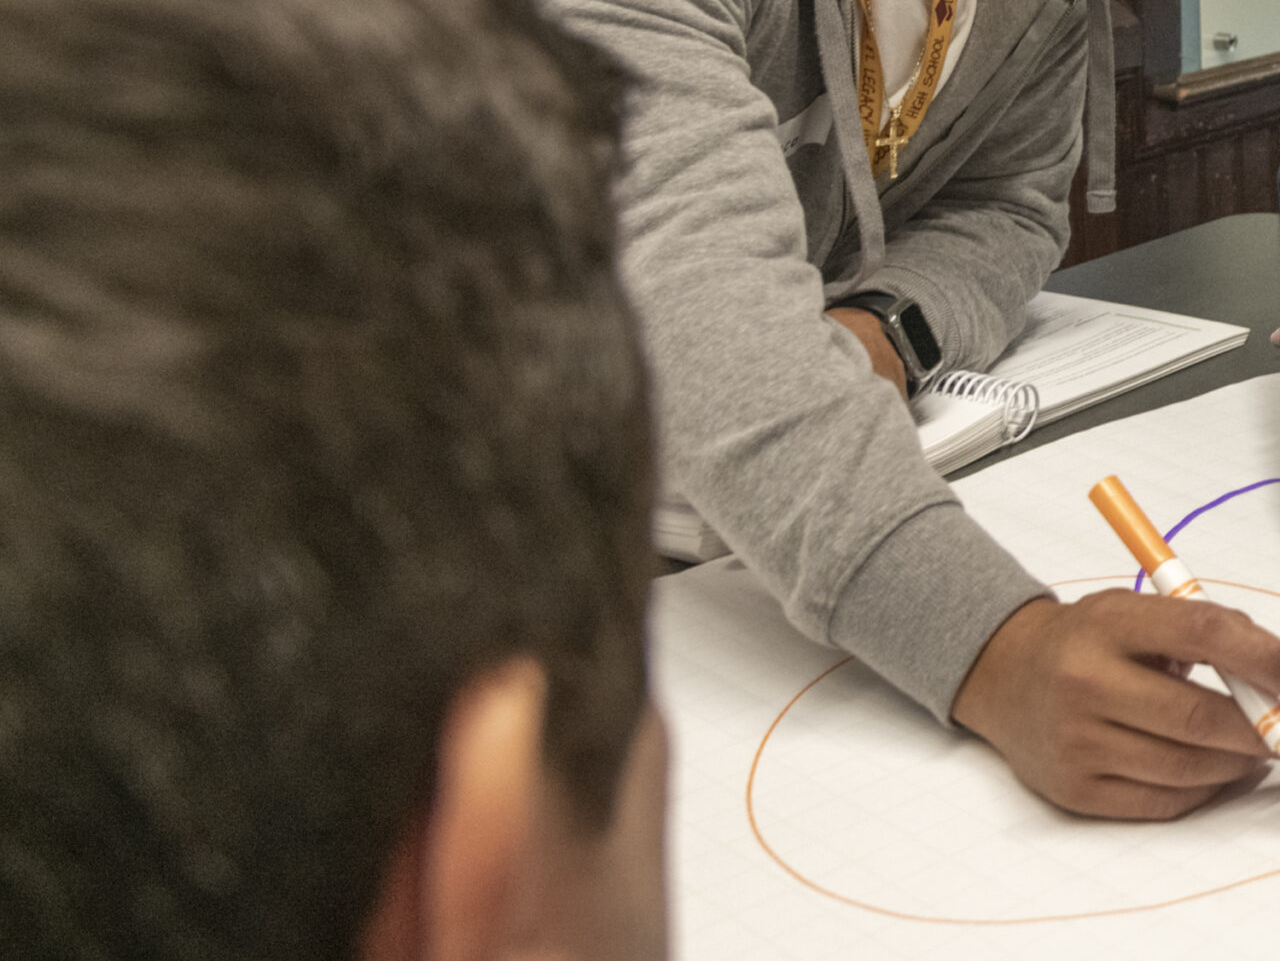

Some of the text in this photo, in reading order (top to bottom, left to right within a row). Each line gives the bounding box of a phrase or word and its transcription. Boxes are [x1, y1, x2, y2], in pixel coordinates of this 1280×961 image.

[859, 68, 875, 125] LEGACY
[905, 36, 945, 119] HIGH SCHOOL
